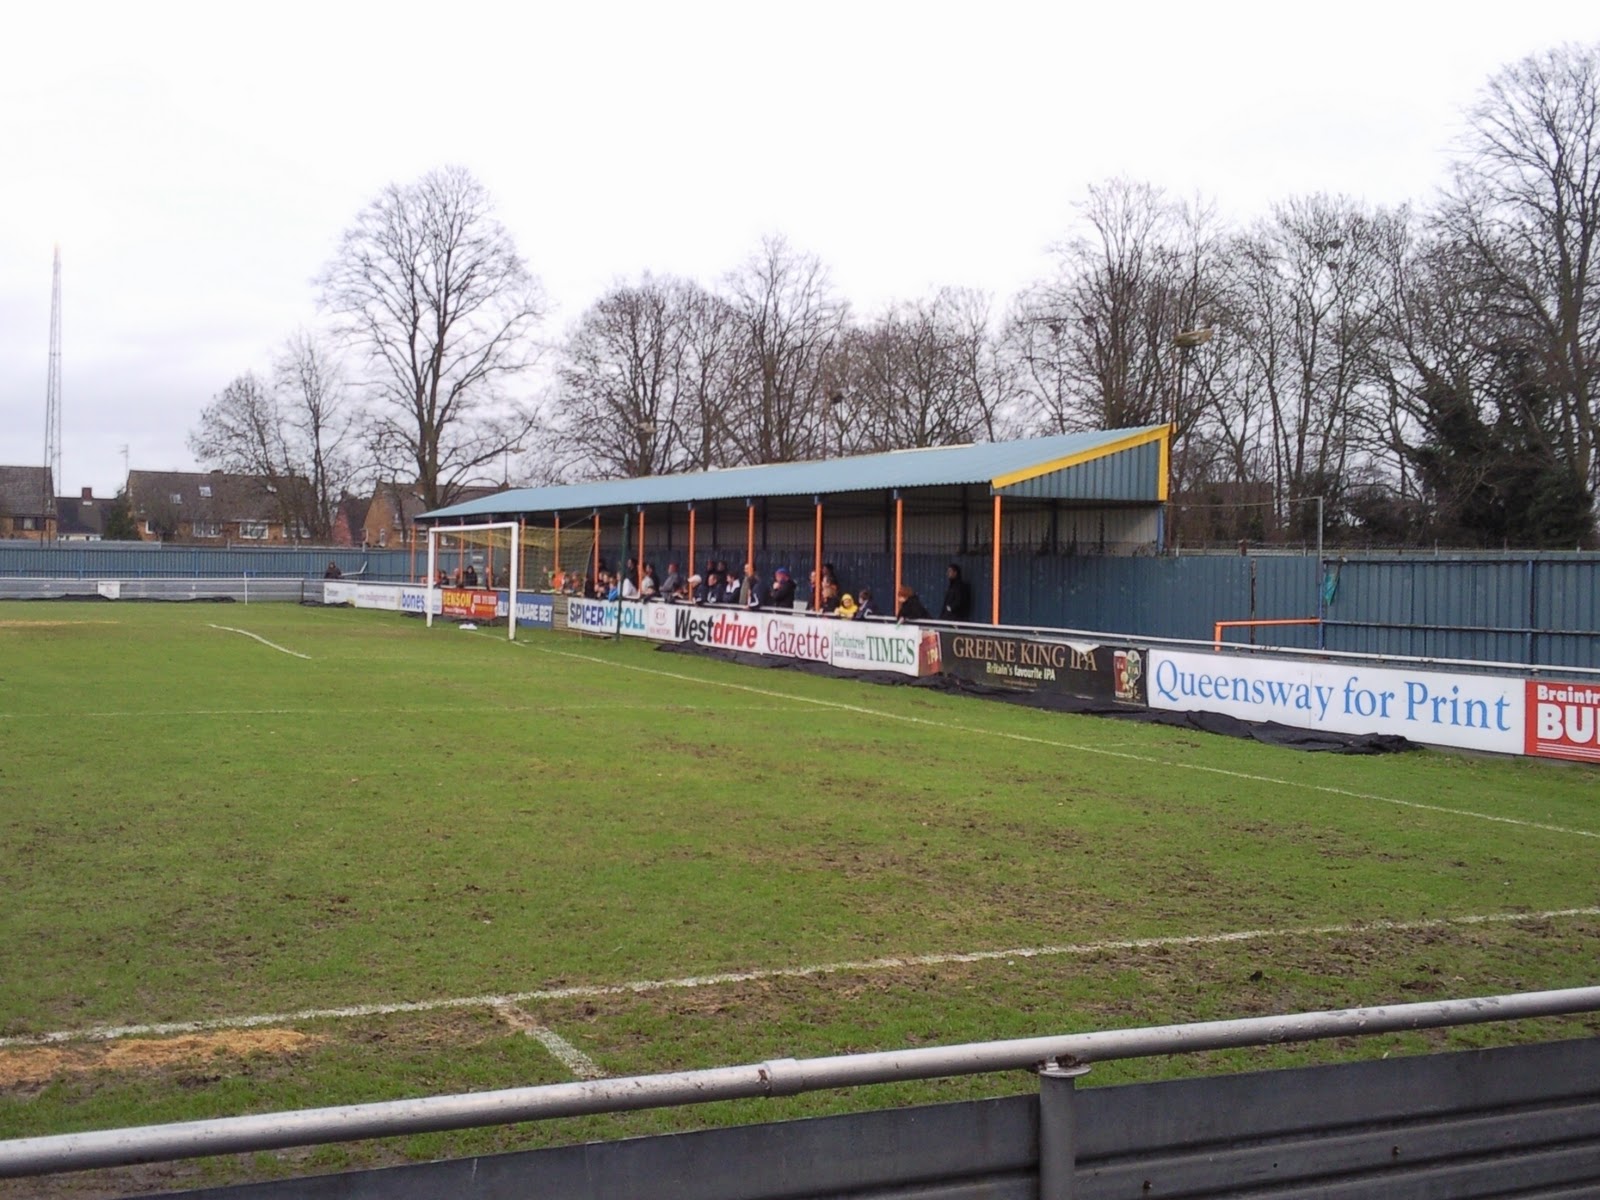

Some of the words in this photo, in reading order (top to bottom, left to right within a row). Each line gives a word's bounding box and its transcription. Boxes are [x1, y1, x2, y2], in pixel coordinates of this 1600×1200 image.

[539, 605, 553, 622] BET
[674, 607, 758, 649] Westdrive
[767, 619, 830, 660] Gazette
[866, 636, 915, 666] TIMES
[952, 636, 1019, 664] GREENE
[1020, 642, 1066, 668] KING
[986, 661, 1014, 676] Britain's
[1014, 664, 1043, 680] favourite
[1043, 667, 1056, 681] IPA
[1155, 659, 1334, 721] Queensway
[1343, 676, 1395, 718] for
[1404, 681, 1512, 732] Print
[1537, 702, 1600, 744] BU
